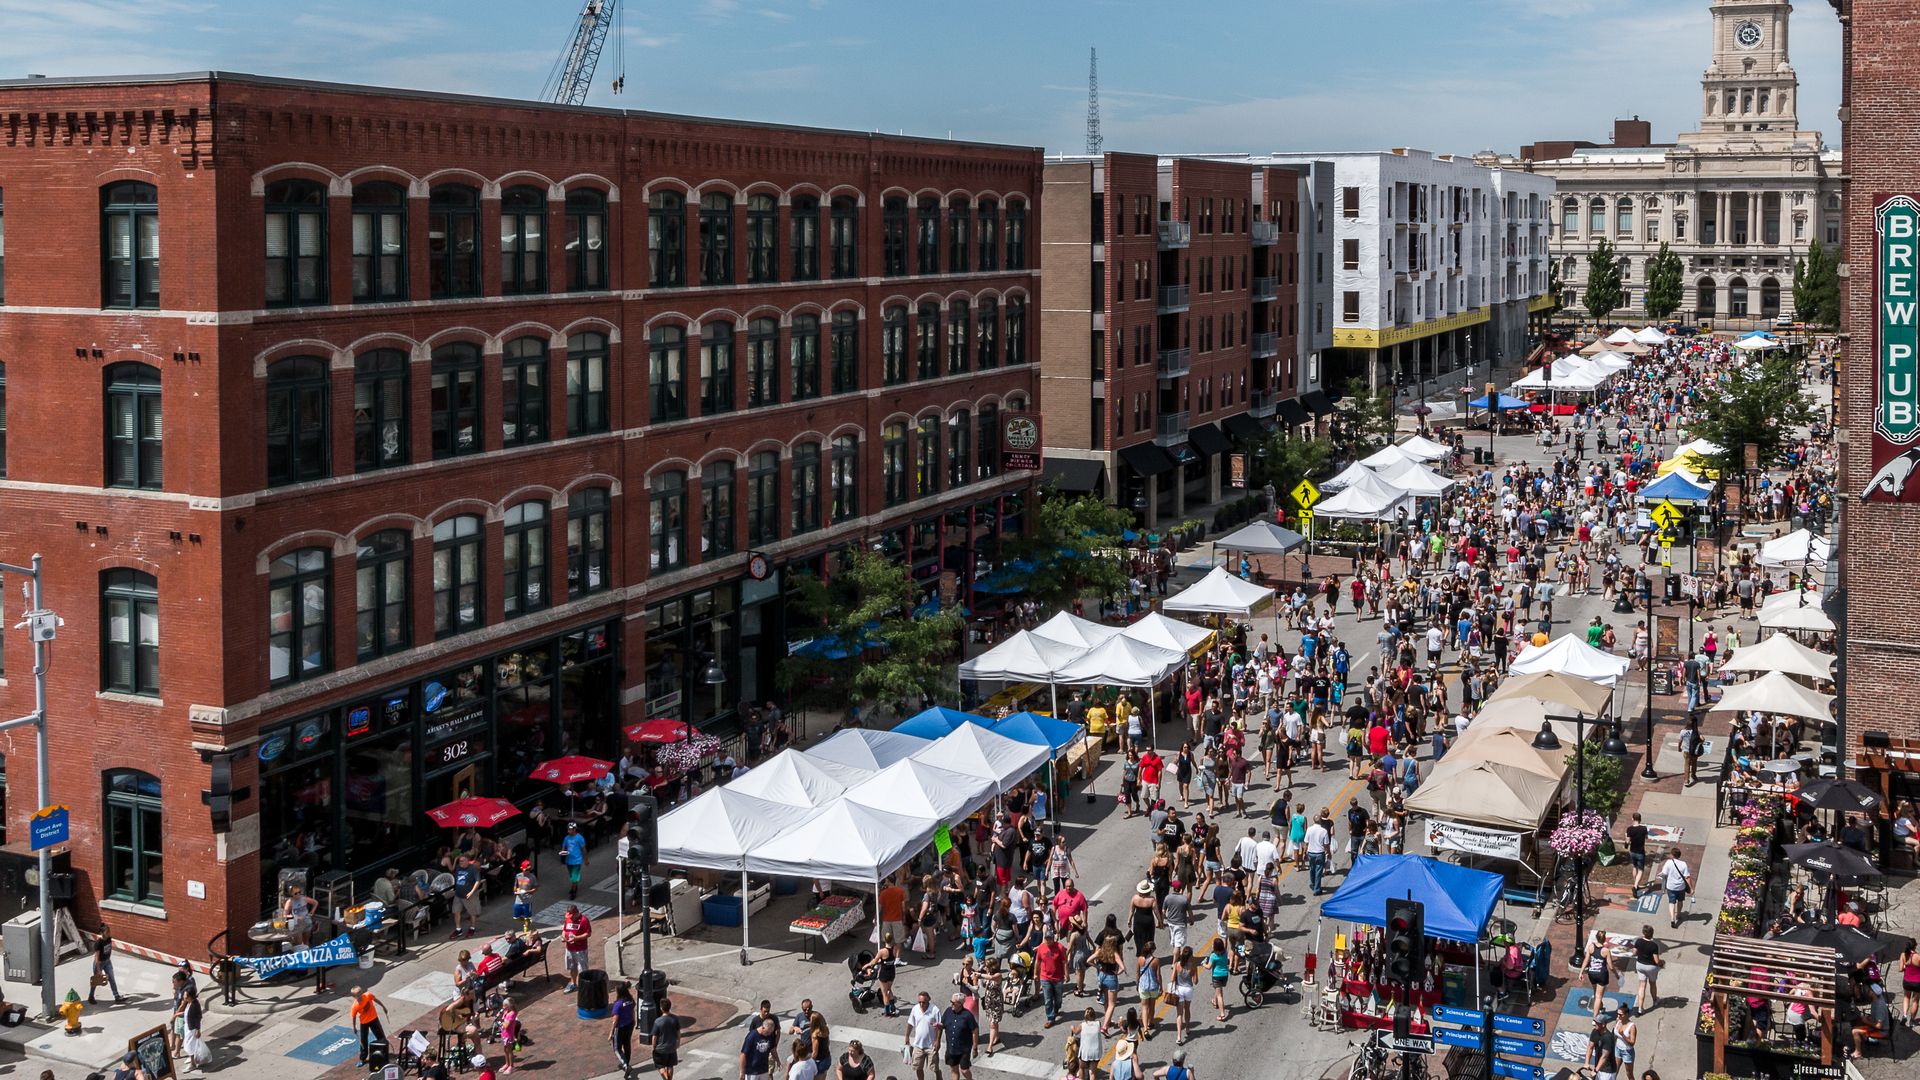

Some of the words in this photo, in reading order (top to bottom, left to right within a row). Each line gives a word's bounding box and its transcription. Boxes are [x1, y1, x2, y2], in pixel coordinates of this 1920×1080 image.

[1884, 214, 1916, 325] BREW
[1888, 343, 1912, 425] PUB
[449, 717, 463, 727] HALL
[470, 710, 484, 719] FAME
[443, 740, 468, 762] 302
[35, 825, 51, 834] Court
[40, 828, 60, 839] District
[1460, 828, 1491, 839] Family
[1494, 833, 1518, 843] Farm
[1806, 858, 1833, 869] GUINNESS
[301, 947, 333, 963] PIZZA
[335, 952, 355, 960] LIGHT
[1445, 1008, 1464, 1017] Science
[1464, 1011, 1481, 1019] Center
[1493, 1015, 1506, 1023] Civic
[1506, 1017, 1523, 1025] Center
[1445, 1031, 1467, 1041] Principal
[1394, 1038, 1410, 1047] ONE
[1412, 1039, 1429, 1049] WAY
[1495, 1038, 1523, 1047] Convention
[1495, 1044, 1517, 1052] Complex
[1494, 1060, 1511, 1069] Events
[1510, 1063, 1528, 1072] Center
[1801, 1065, 1818, 1075] FEED
[1824, 1067, 1841, 1077] SOUL
